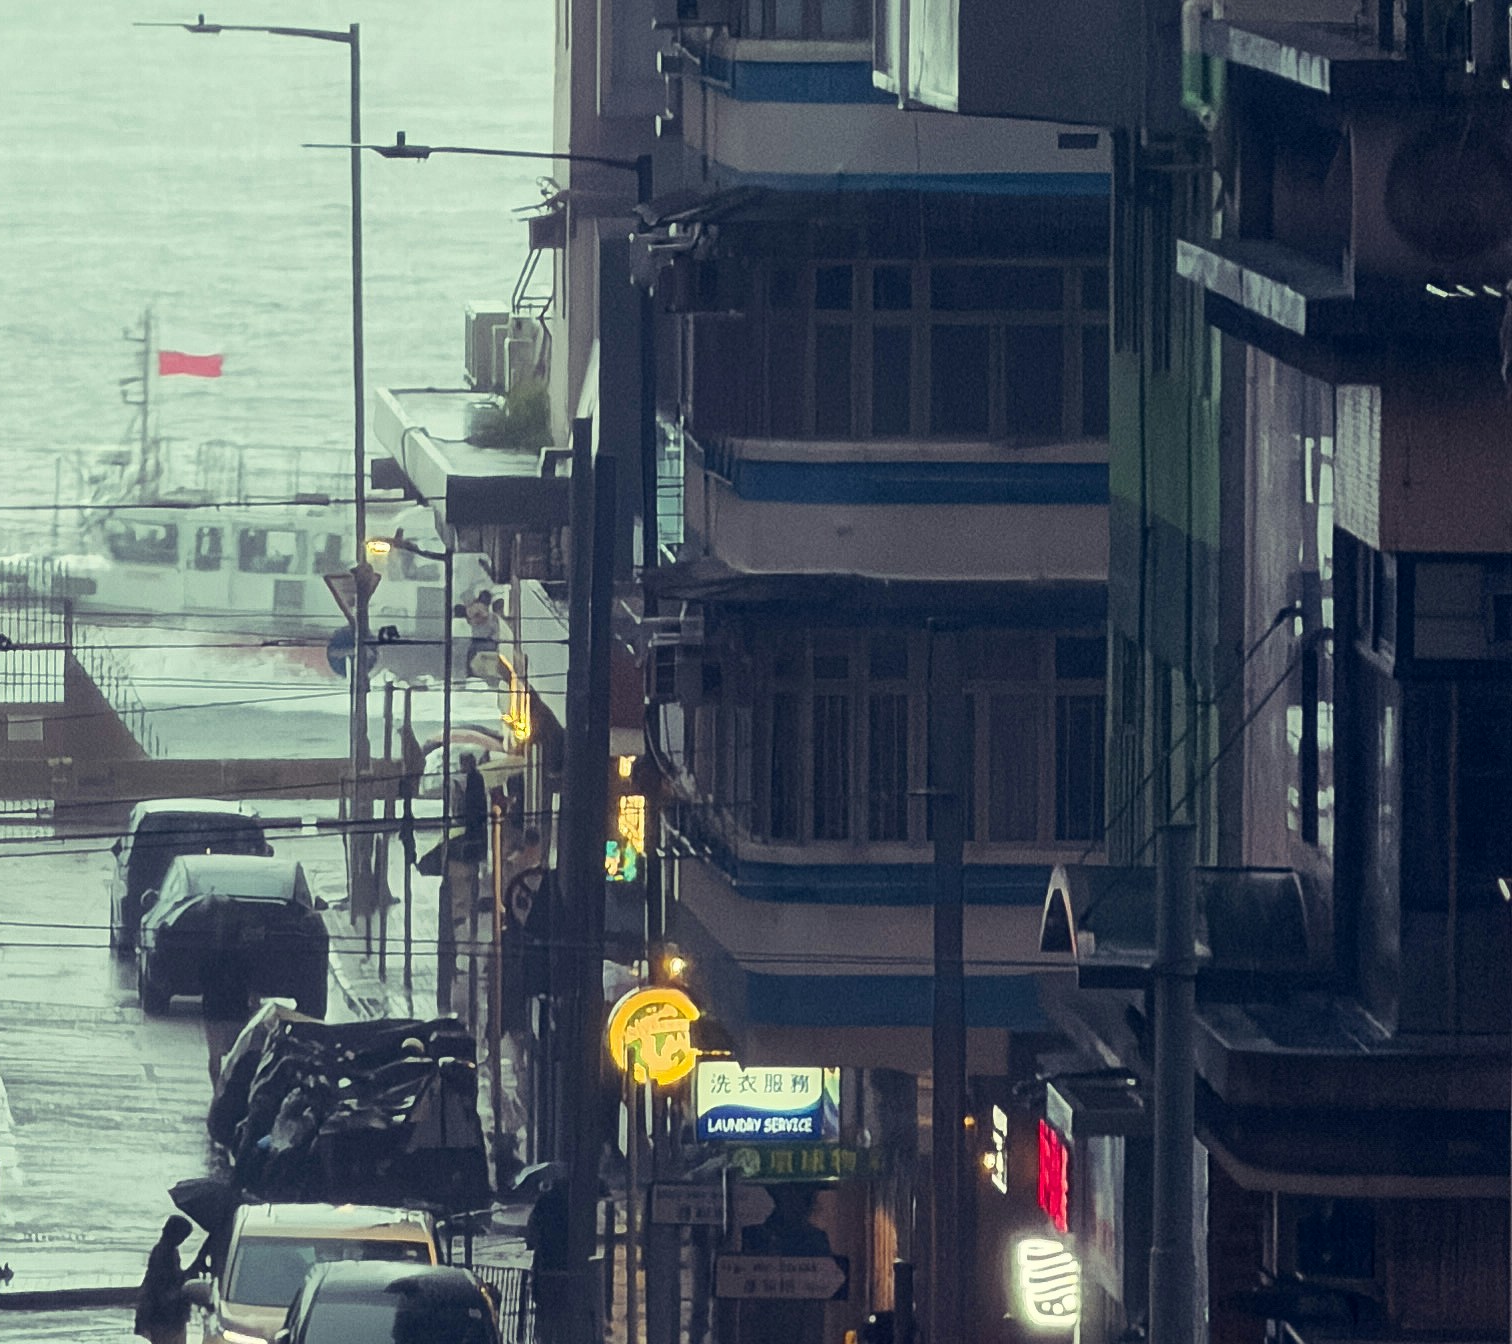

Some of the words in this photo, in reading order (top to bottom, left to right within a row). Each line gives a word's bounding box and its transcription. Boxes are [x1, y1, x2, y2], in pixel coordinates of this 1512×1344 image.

[710, 1073, 810, 1094] 洗衣服務
[707, 1117, 762, 1133] LAUNDRY
[763, 1117, 813, 1133] SERVICE
